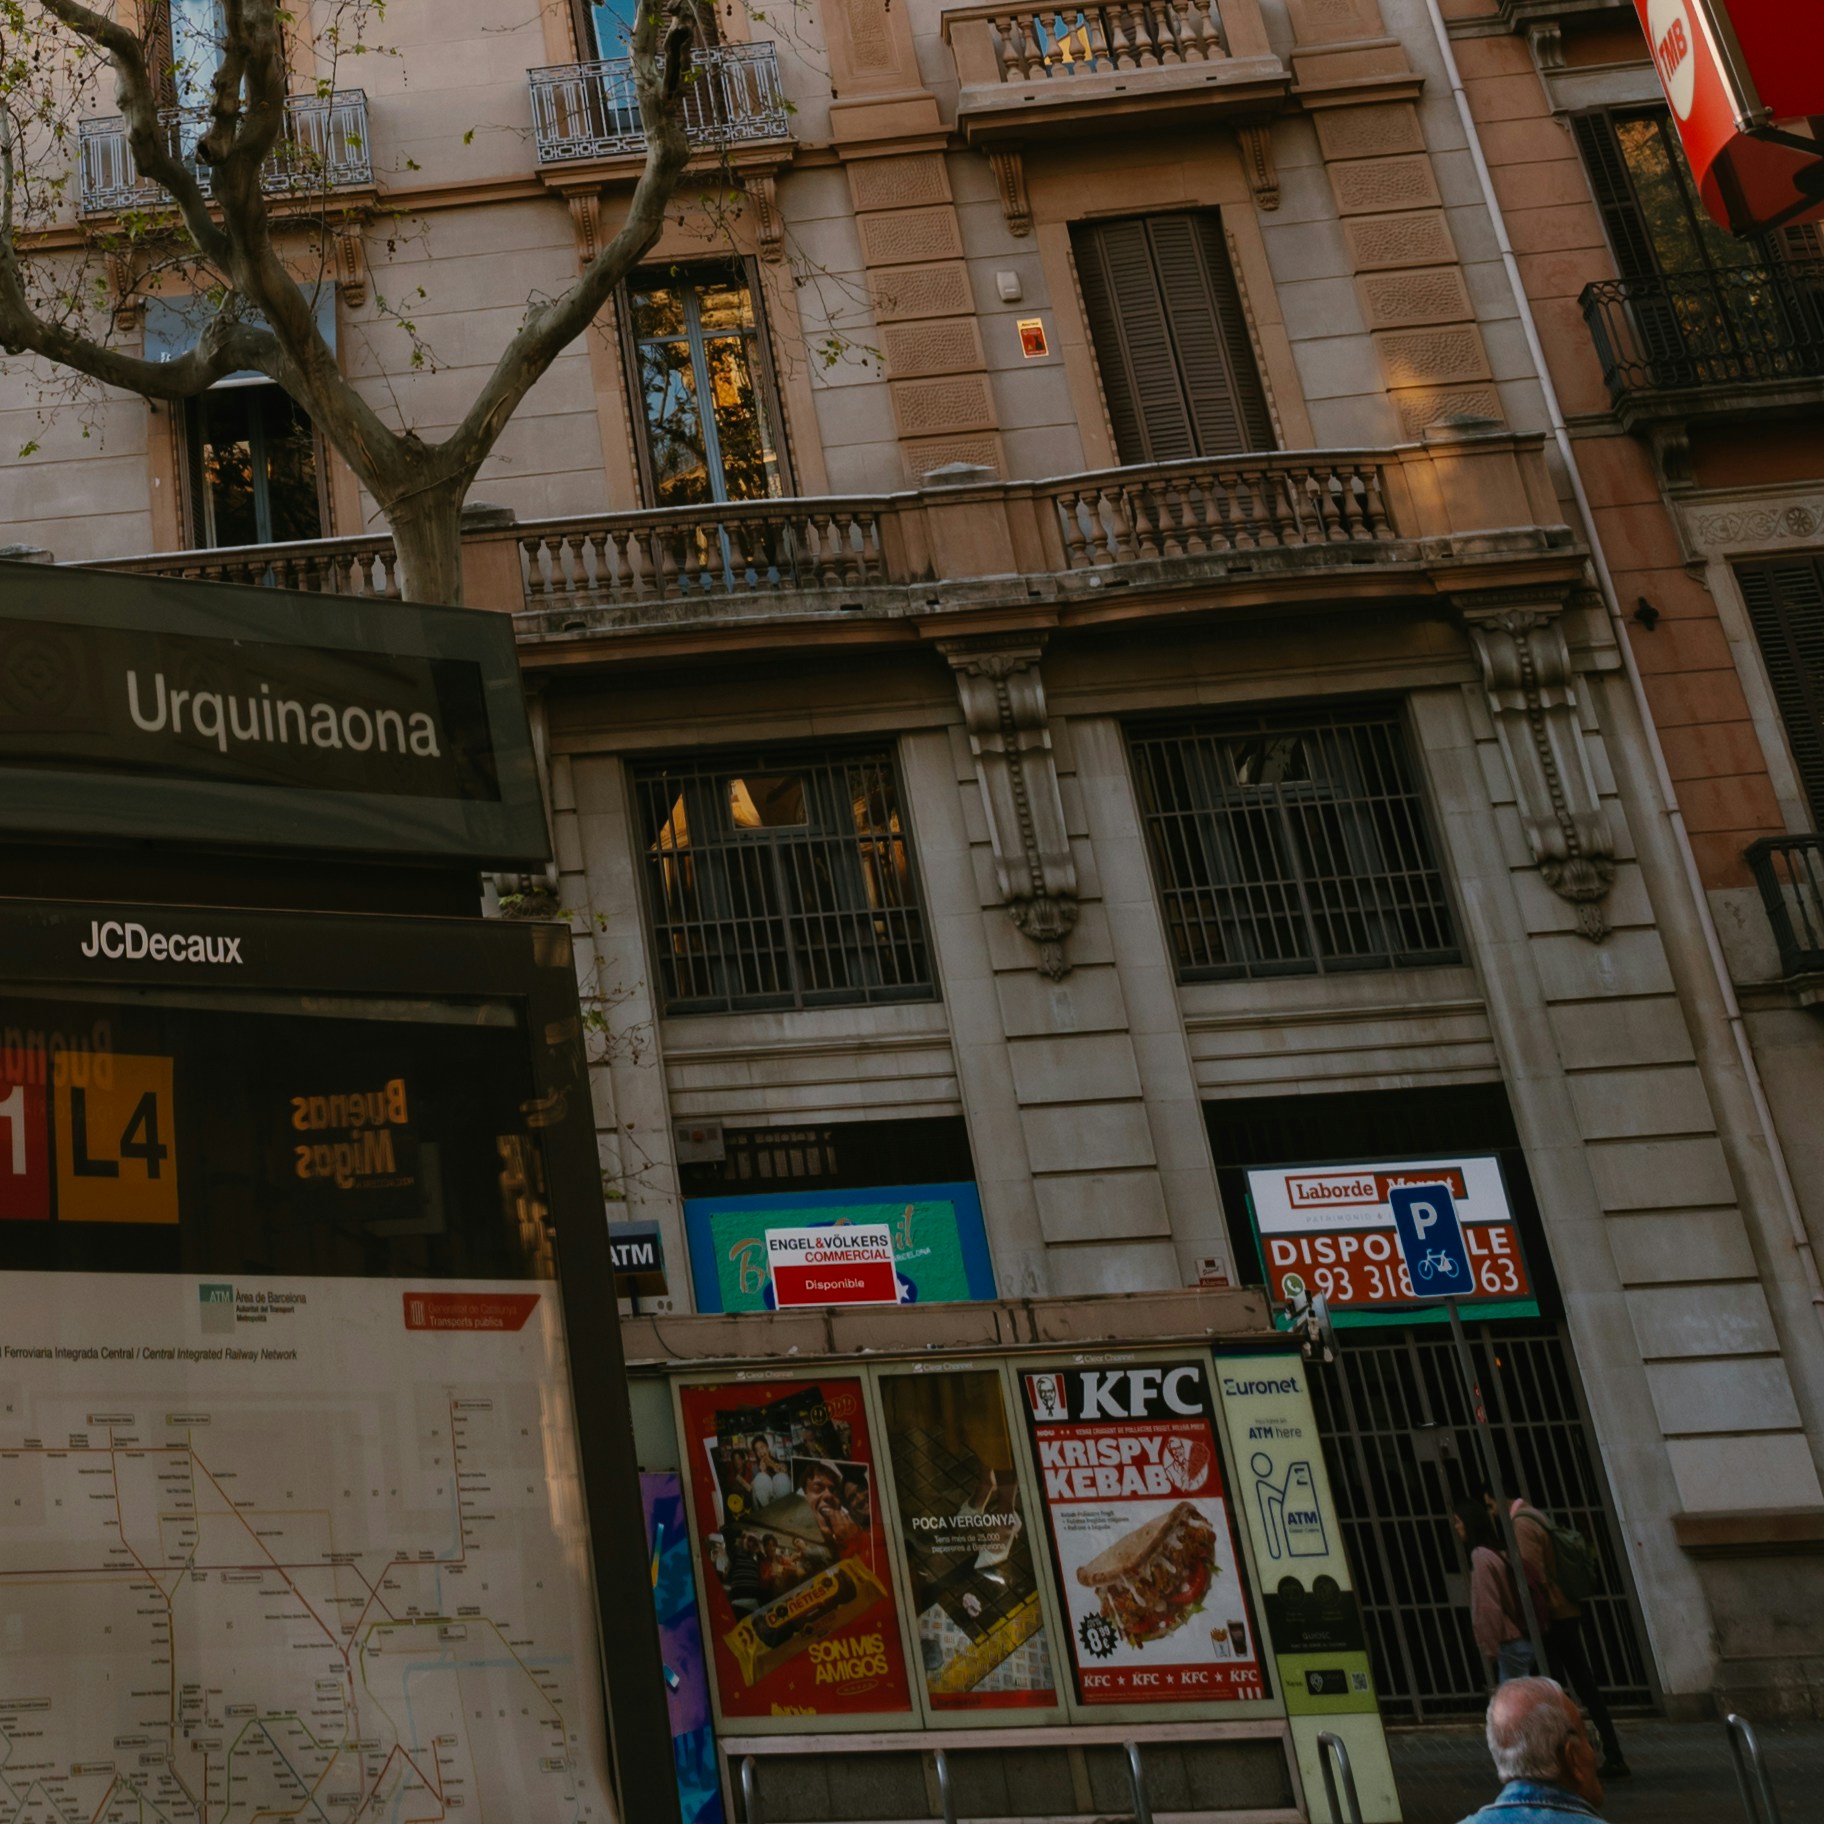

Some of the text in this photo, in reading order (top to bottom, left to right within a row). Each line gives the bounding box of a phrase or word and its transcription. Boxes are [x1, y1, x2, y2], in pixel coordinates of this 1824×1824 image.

[1659, 18, 1687, 81] TMB
[125, 669, 442, 759] Urquinaona
[81, 919, 244, 966] JCDecaux
[71, 1087, 168, 1180] L4
[1296, 1180, 1374, 1200] Laborde
[1409, 1201, 1438, 1240] P
[769, 1234, 888, 1252] ENGEL&VÖLKERS
[1271, 1228, 1511, 1267] DISPOLE
[610, 1242, 654, 1266] ATM
[805, 1249, 891, 1264] COMMERCIAL
[805, 1277, 865, 1291] Disponible
[1314, 1266, 1354, 1301] 93
[210, 1291, 230, 1303] ATM
[255, 1292, 266, 1303] de
[267, 1292, 307, 1304] Barcelona
[429, 1315, 473, 1328] Transports
[4, 1346, 53, 1359] Ferroviaria
[55, 1347, 99, 1361] Integrada
[101, 1347, 134, 1360] Central
[142, 1348, 175, 1360] Central
[177, 1348, 223, 1362] Integrated
[225, 1348, 259, 1363] Railway
[261, 1349, 298, 1360] Network
[1084, 1351, 1135, 1363] Clear Channel
[1080, 1366, 1203, 1419] KFC
[1224, 1376, 1298, 1396] Euronet
[1249, 1426, 1302, 1439] ATM here
[1039, 1436, 1163, 1468] KRISPY
[1044, 1464, 1172, 1499] KEBAB
[912, 1513, 1017, 1530] POCA VERGONYA
[1288, 1512, 1318, 1525] ATM
[967, 1534, 976, 1542] de
[809, 1633, 885, 1663] SON MIS
[815, 1654, 889, 1684] AMIGOS
[1084, 1668, 1258, 1687] KFC KFC KFC KFC
